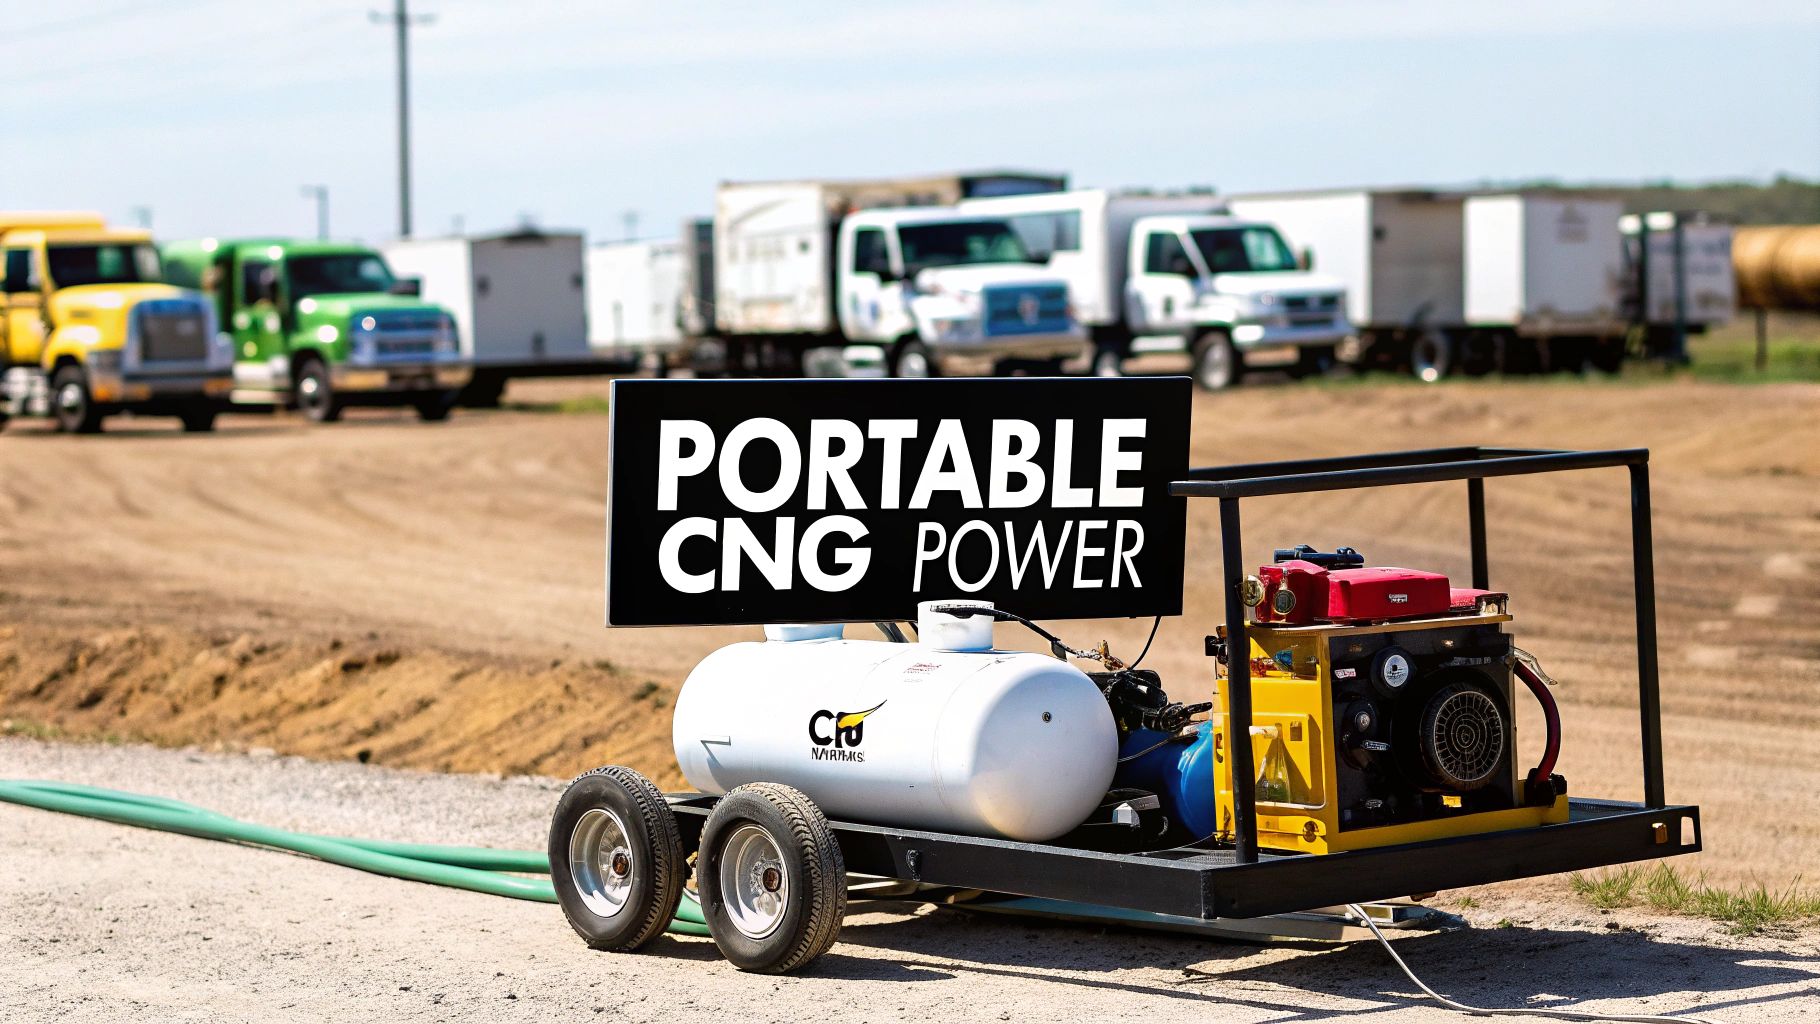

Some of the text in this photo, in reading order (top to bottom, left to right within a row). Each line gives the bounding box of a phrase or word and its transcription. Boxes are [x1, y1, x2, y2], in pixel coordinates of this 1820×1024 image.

[658, 418, 1147, 512] PORTABLE
[658, 515, 1146, 594] CNG POWER
